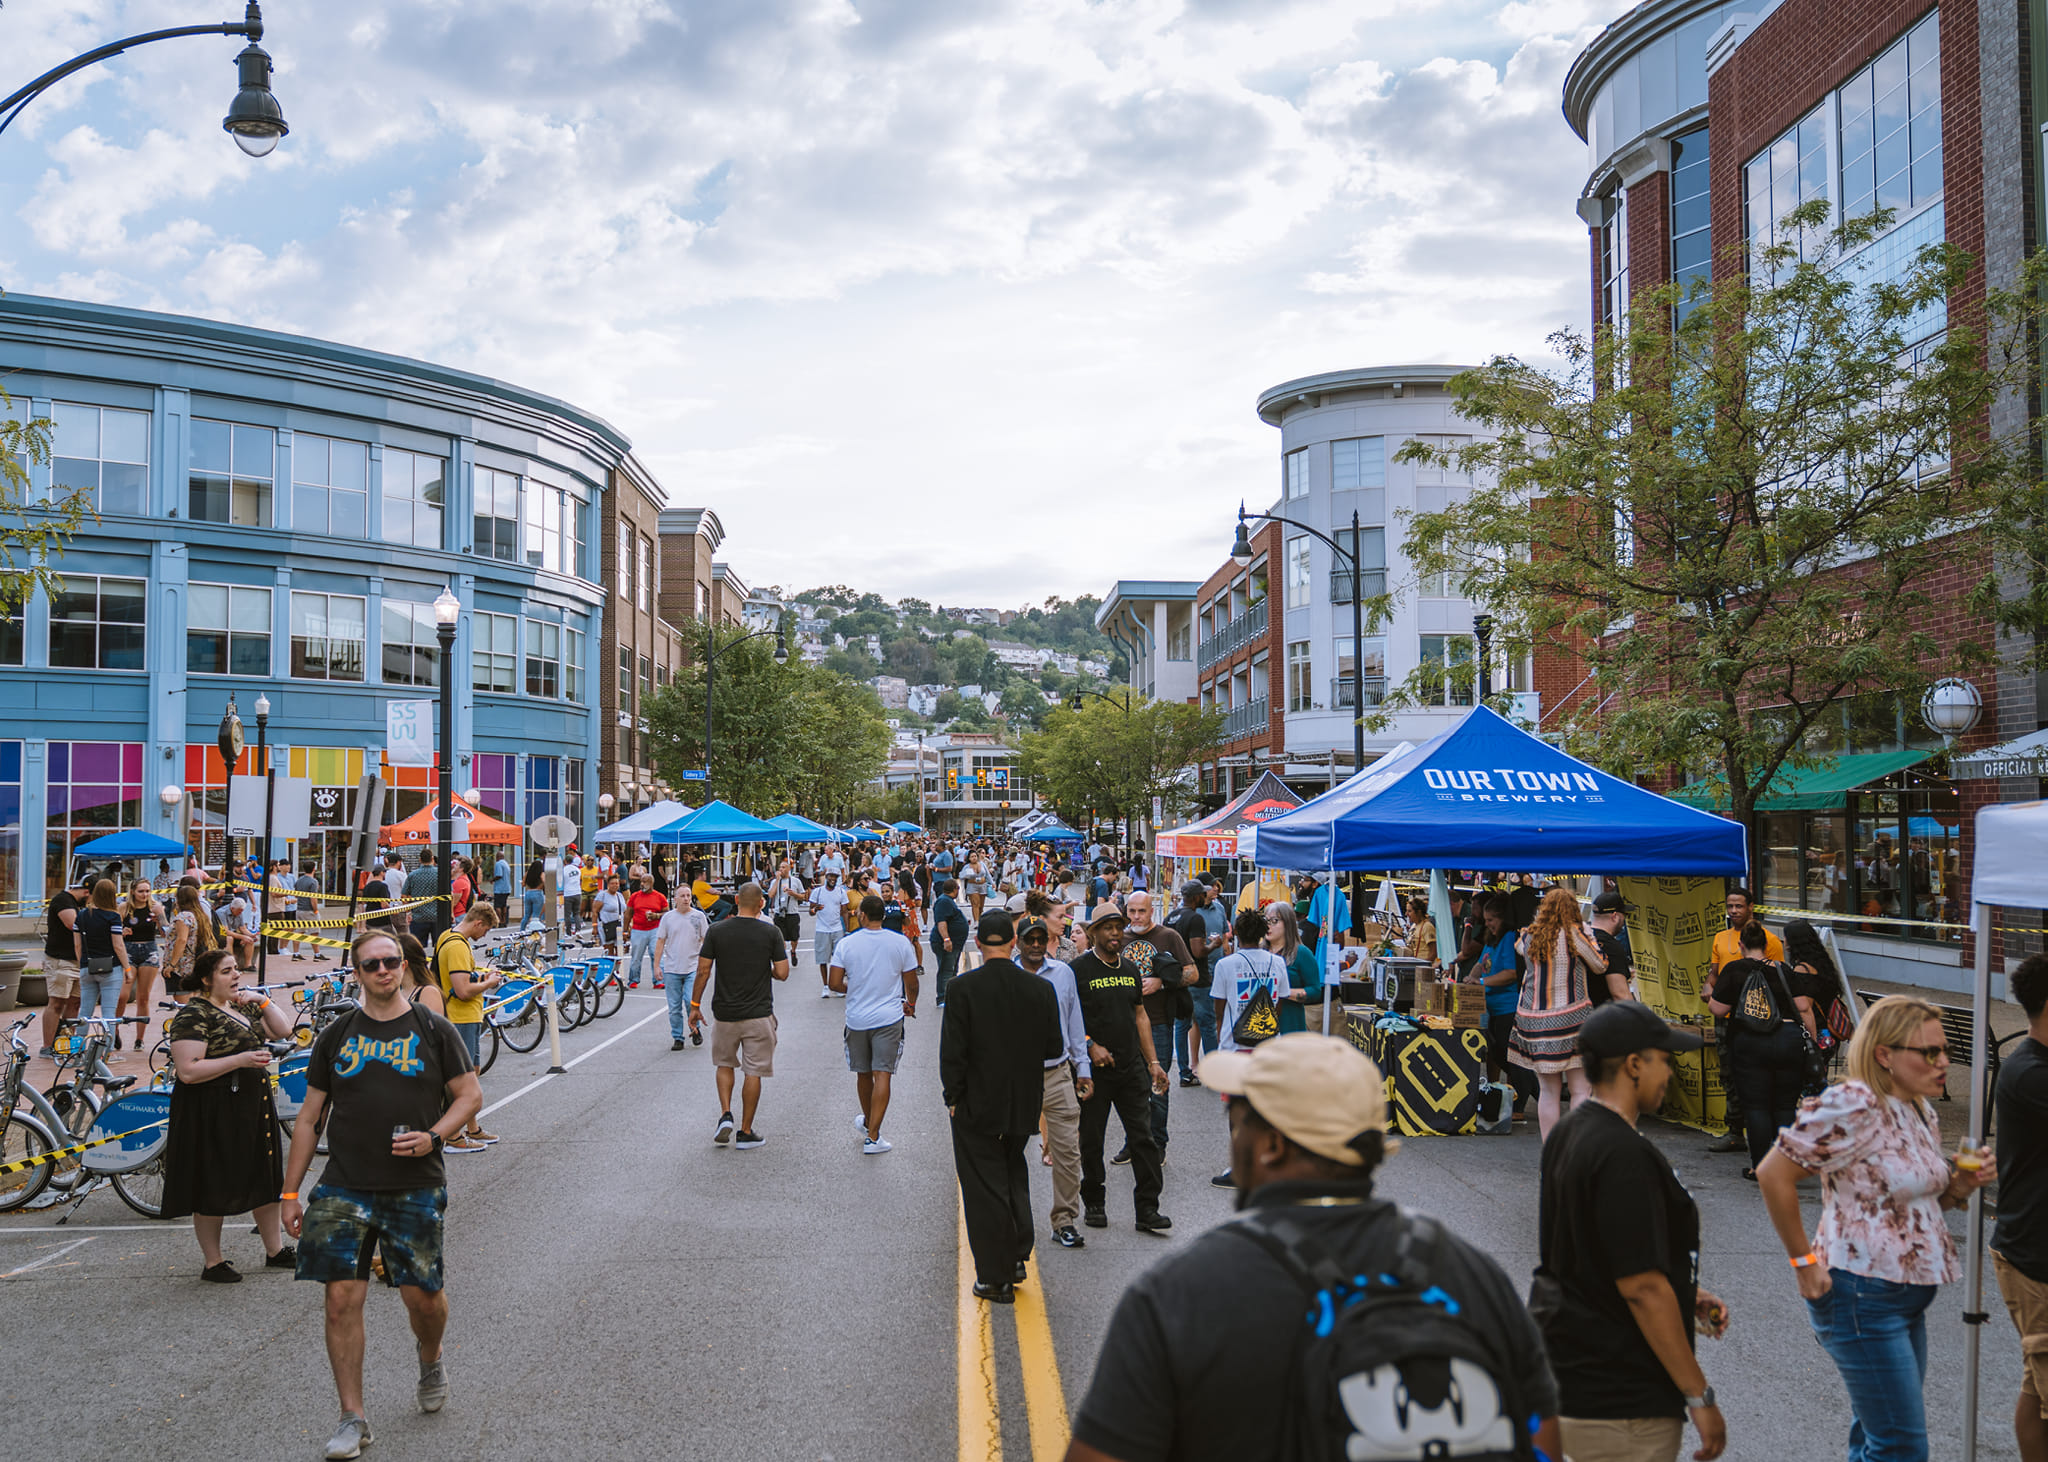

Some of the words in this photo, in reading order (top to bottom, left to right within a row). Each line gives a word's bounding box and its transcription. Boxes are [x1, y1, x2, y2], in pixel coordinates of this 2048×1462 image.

[1983, 761, 2033, 777] OFFICIAL
[1423, 768, 1496, 790] OUR
[1493, 769, 1600, 792] TOWN
[1460, 794, 1577, 803] BREWERY
[404, 831, 430, 840] FOUR
[1206, 839, 1238, 858] RE
[1030, 916, 1038, 924] P
[1089, 976, 1136, 990] FRESHER
